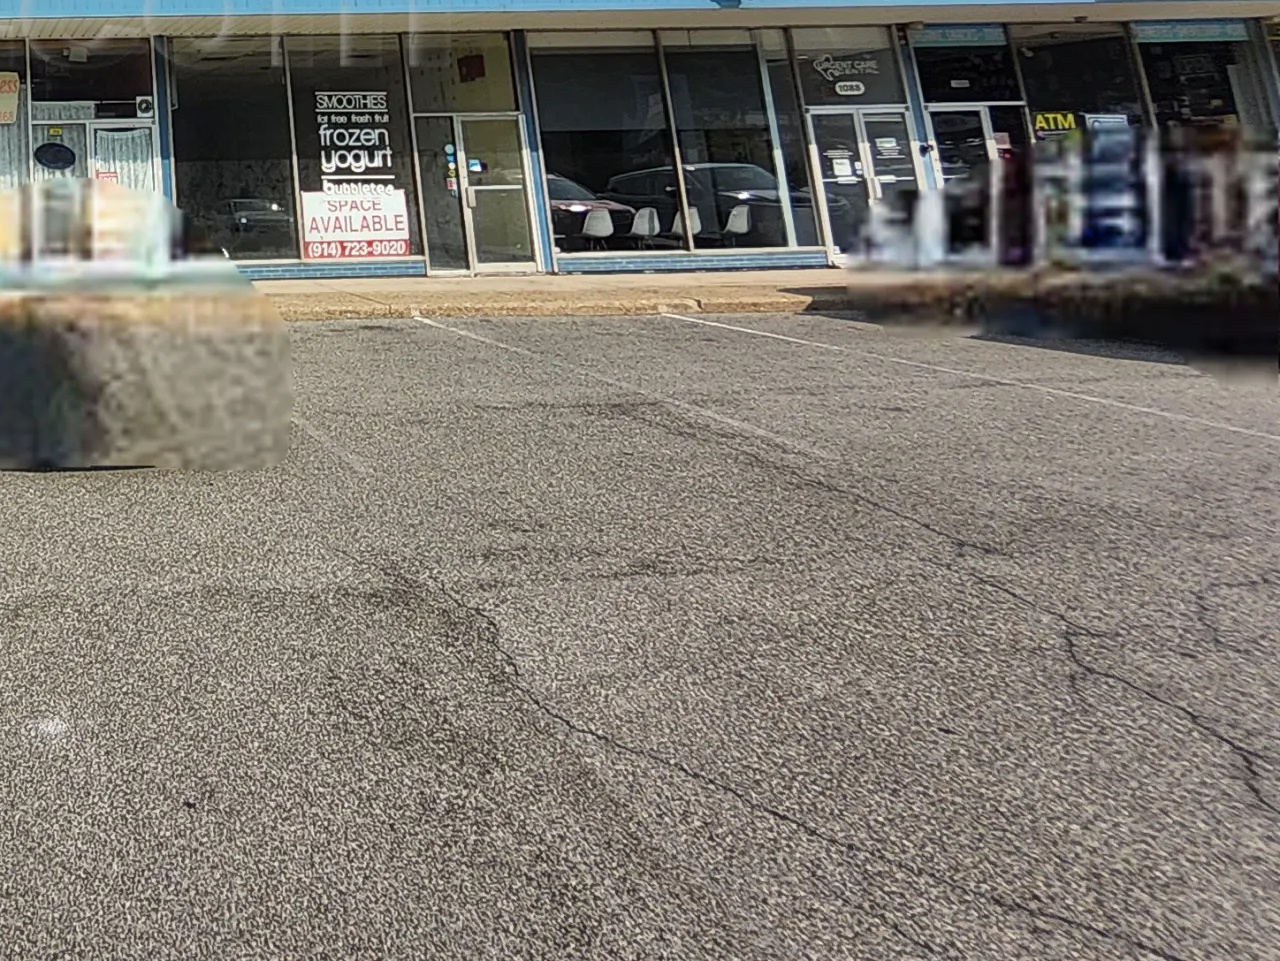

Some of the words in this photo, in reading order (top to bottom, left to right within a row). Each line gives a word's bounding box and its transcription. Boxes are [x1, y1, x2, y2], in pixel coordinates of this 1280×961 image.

[316, 95, 387, 109] SMOOTHIES
[1035, 113, 1077, 130] ATM
[319, 124, 389, 146] frozen
[321, 146, 393, 173] yogurt
[327, 199, 383, 213] SPACE
[309, 214, 406, 234] AVAILABLE
[308, 241, 341, 258] (914)
[343, 241, 407, 256] 723-9020
